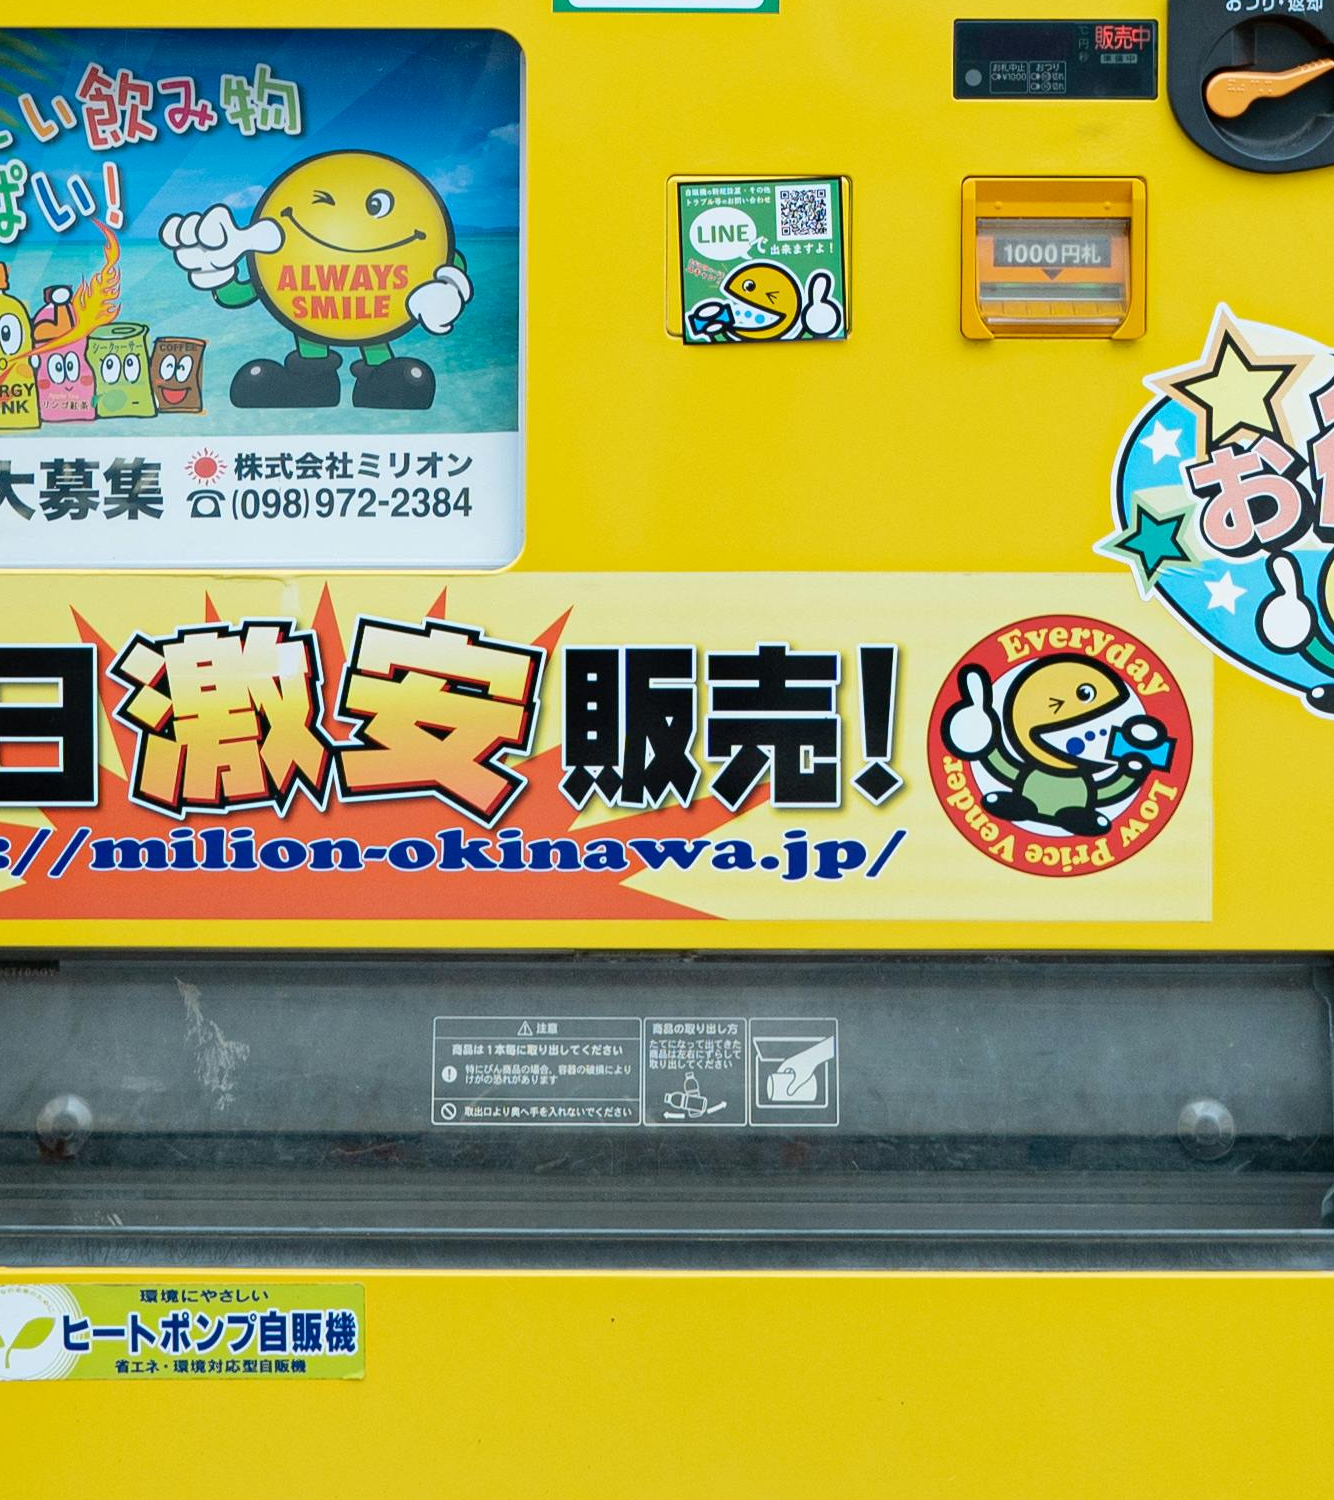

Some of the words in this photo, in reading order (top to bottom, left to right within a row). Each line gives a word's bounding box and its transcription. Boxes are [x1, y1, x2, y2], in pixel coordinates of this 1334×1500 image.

[1095, 25, 1151, 50] 販売中
[697, 224, 750, 244] LINE
[1003, 242, 1101, 264] 1000円札
[276, 263, 409, 293] ALWAYS
[291, 294, 391, 321] SMILE
[159, 343, 197, 352] COFFEE
[234, 451, 474, 480] 株式会社ミリオン
[997, 624, 1171, 698] Everyday
[942, 757, 1019, 864] Vender
[1122, 778, 1179, 847] Low
[1023, 839, 1117, 876] Price
[536, 1022, 558, 1035] 注意
[652, 1022, 738, 1036] 商品の取り出し方
[649, 1059, 733, 1070] 取り出してください
[139, 1289, 269, 1303] 環境にやさしい
[62, 1311, 357, 1355] ヒートポンプ自販機
[115, 1358, 306, 1374] 省エネ・環境対応型自販機
